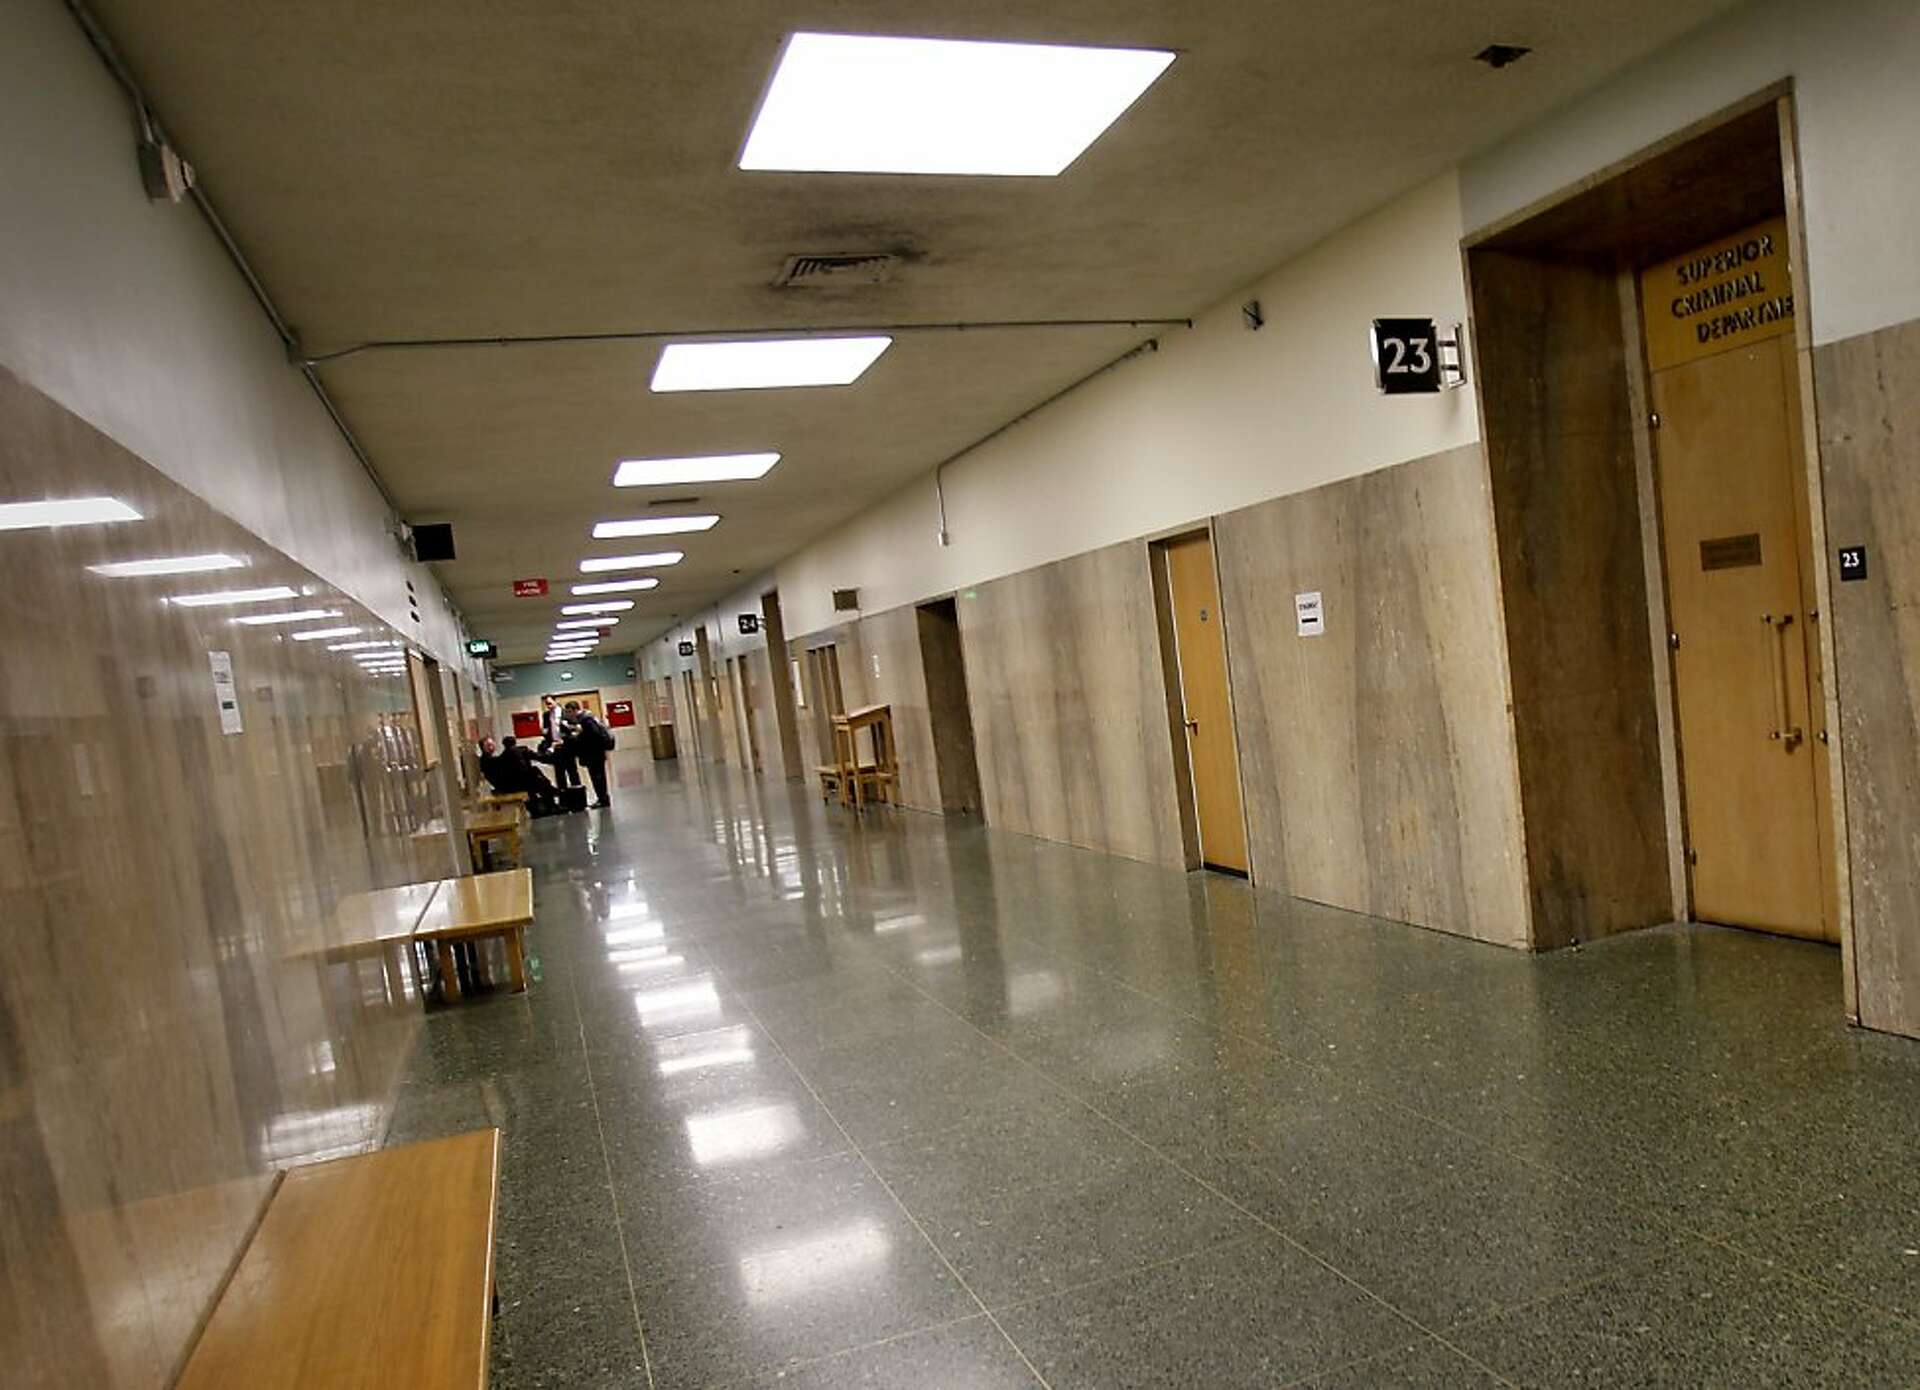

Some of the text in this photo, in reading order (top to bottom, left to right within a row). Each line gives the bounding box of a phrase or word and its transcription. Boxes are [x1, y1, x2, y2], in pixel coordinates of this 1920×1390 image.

[1676, 234, 1775, 285] SUPERIOR
[1671, 271, 1765, 318] CRIMINAL
[1383, 338, 1432, 373] 23
[1842, 552, 1860, 567] 23
